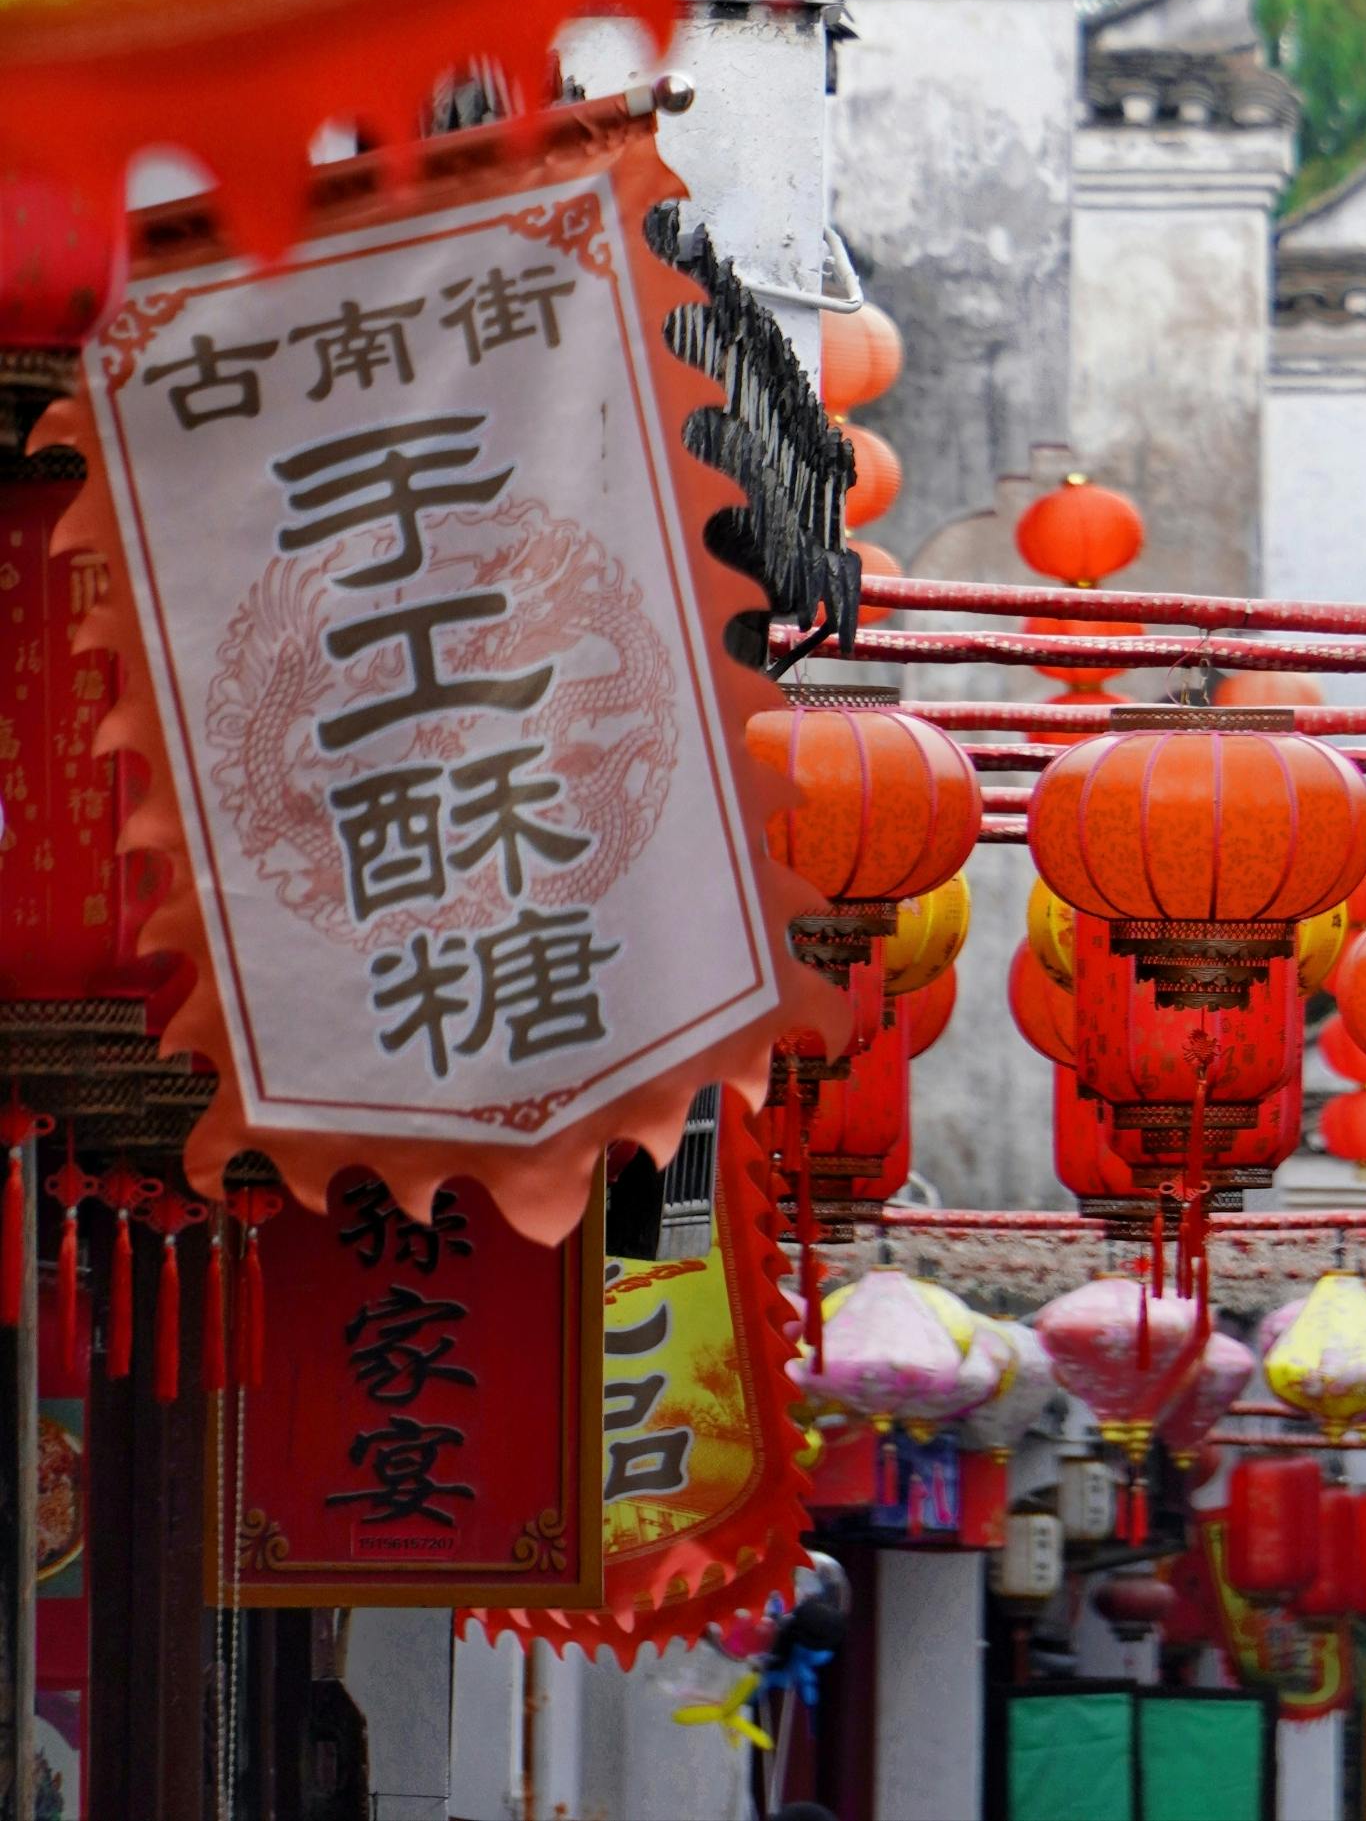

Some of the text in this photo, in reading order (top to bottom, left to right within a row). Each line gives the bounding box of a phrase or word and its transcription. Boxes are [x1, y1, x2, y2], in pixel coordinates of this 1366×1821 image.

[143, 265, 576, 430] 古南街
[271, 414, 622, 1078] 手工酥糖
